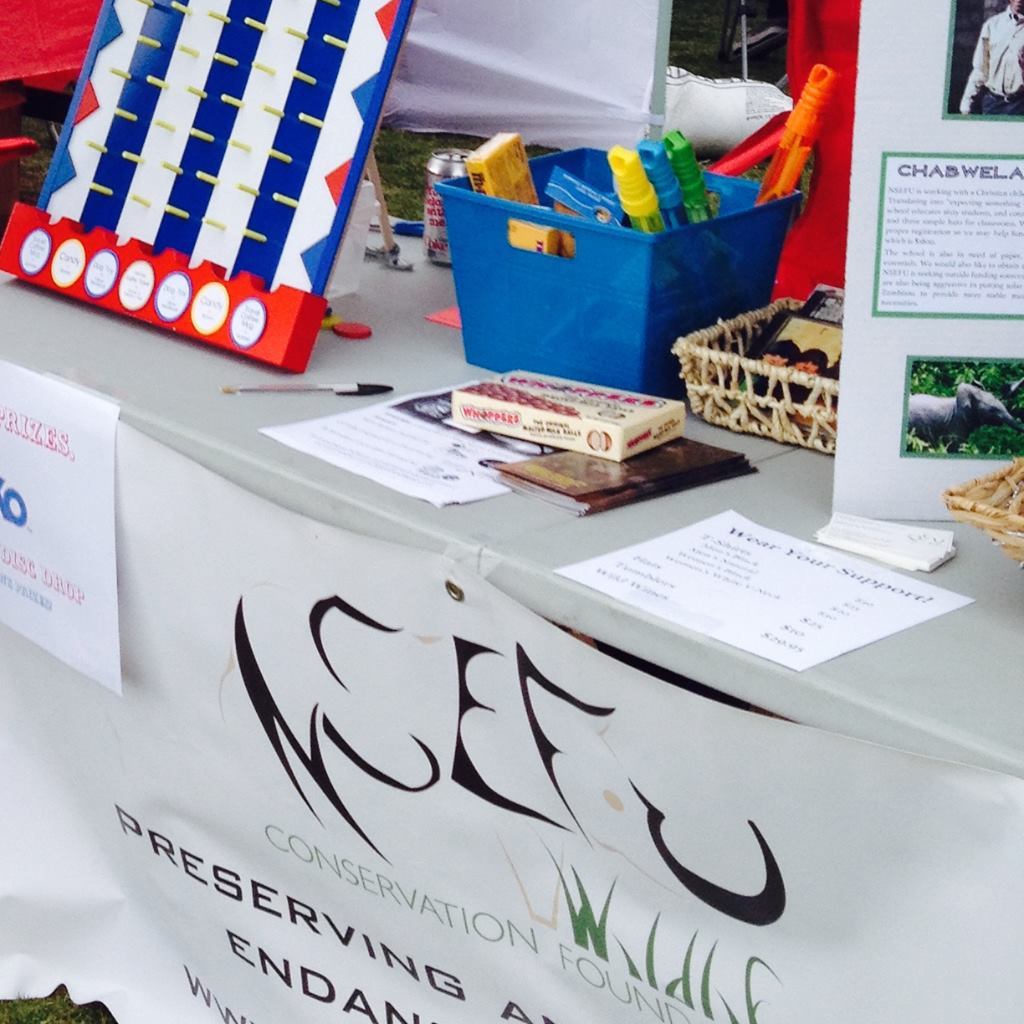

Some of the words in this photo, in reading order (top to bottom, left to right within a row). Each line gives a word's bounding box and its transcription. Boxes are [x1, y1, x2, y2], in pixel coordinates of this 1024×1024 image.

[462, 405, 521, 427] WHOPPERS
[728, 526, 782, 551] Wear
[785, 549, 836, 574] Your
[837, 564, 936, 606] Support!
[114, 803, 466, 1002] PRESERVING
[264, 823, 538, 954] CONSERVATION
[226, 928, 440, 1024] ENDAN
